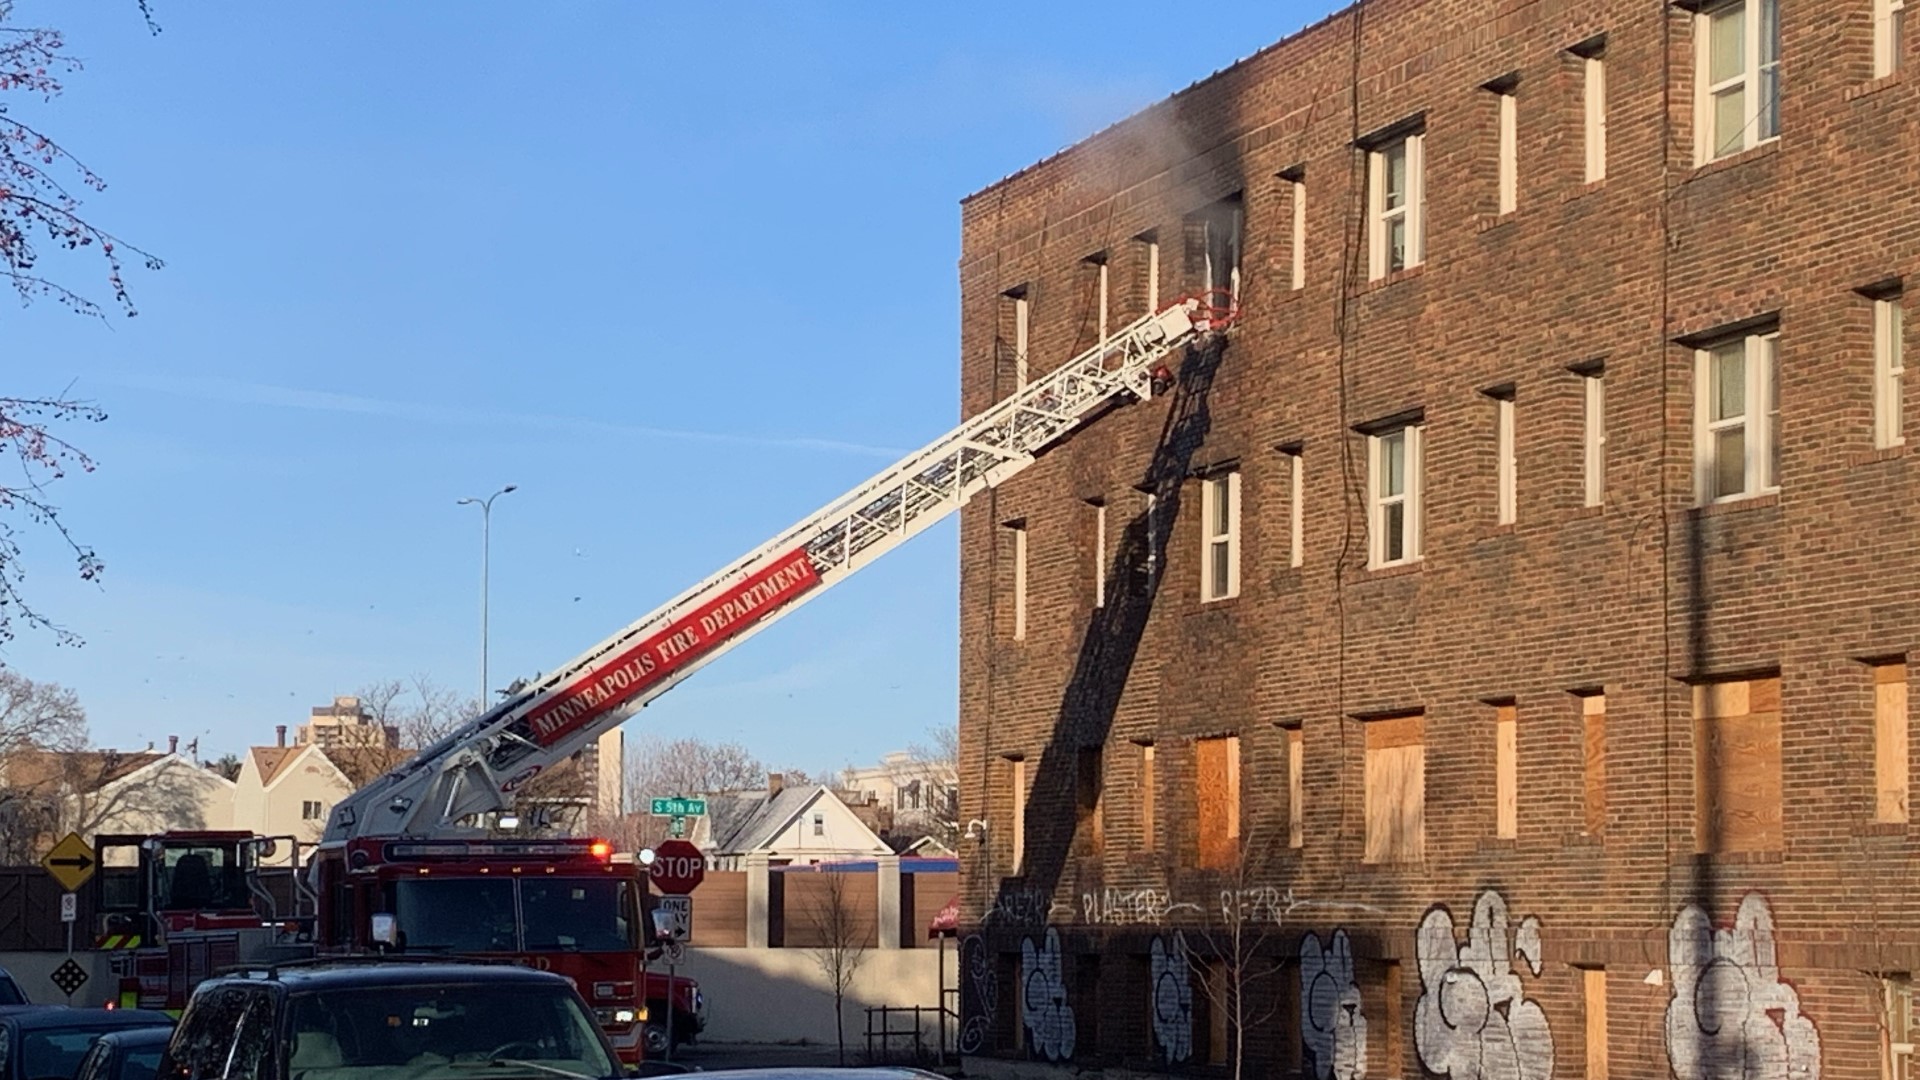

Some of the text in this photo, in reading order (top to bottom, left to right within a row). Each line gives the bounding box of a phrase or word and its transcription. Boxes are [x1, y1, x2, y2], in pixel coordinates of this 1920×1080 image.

[535, 558, 811, 737] MINNEAPOLIS FIRE DEPARTMENT
[655, 801, 702, 813] S 5th Av
[653, 857, 702, 878] STOP
[663, 900, 688, 912] ONE
